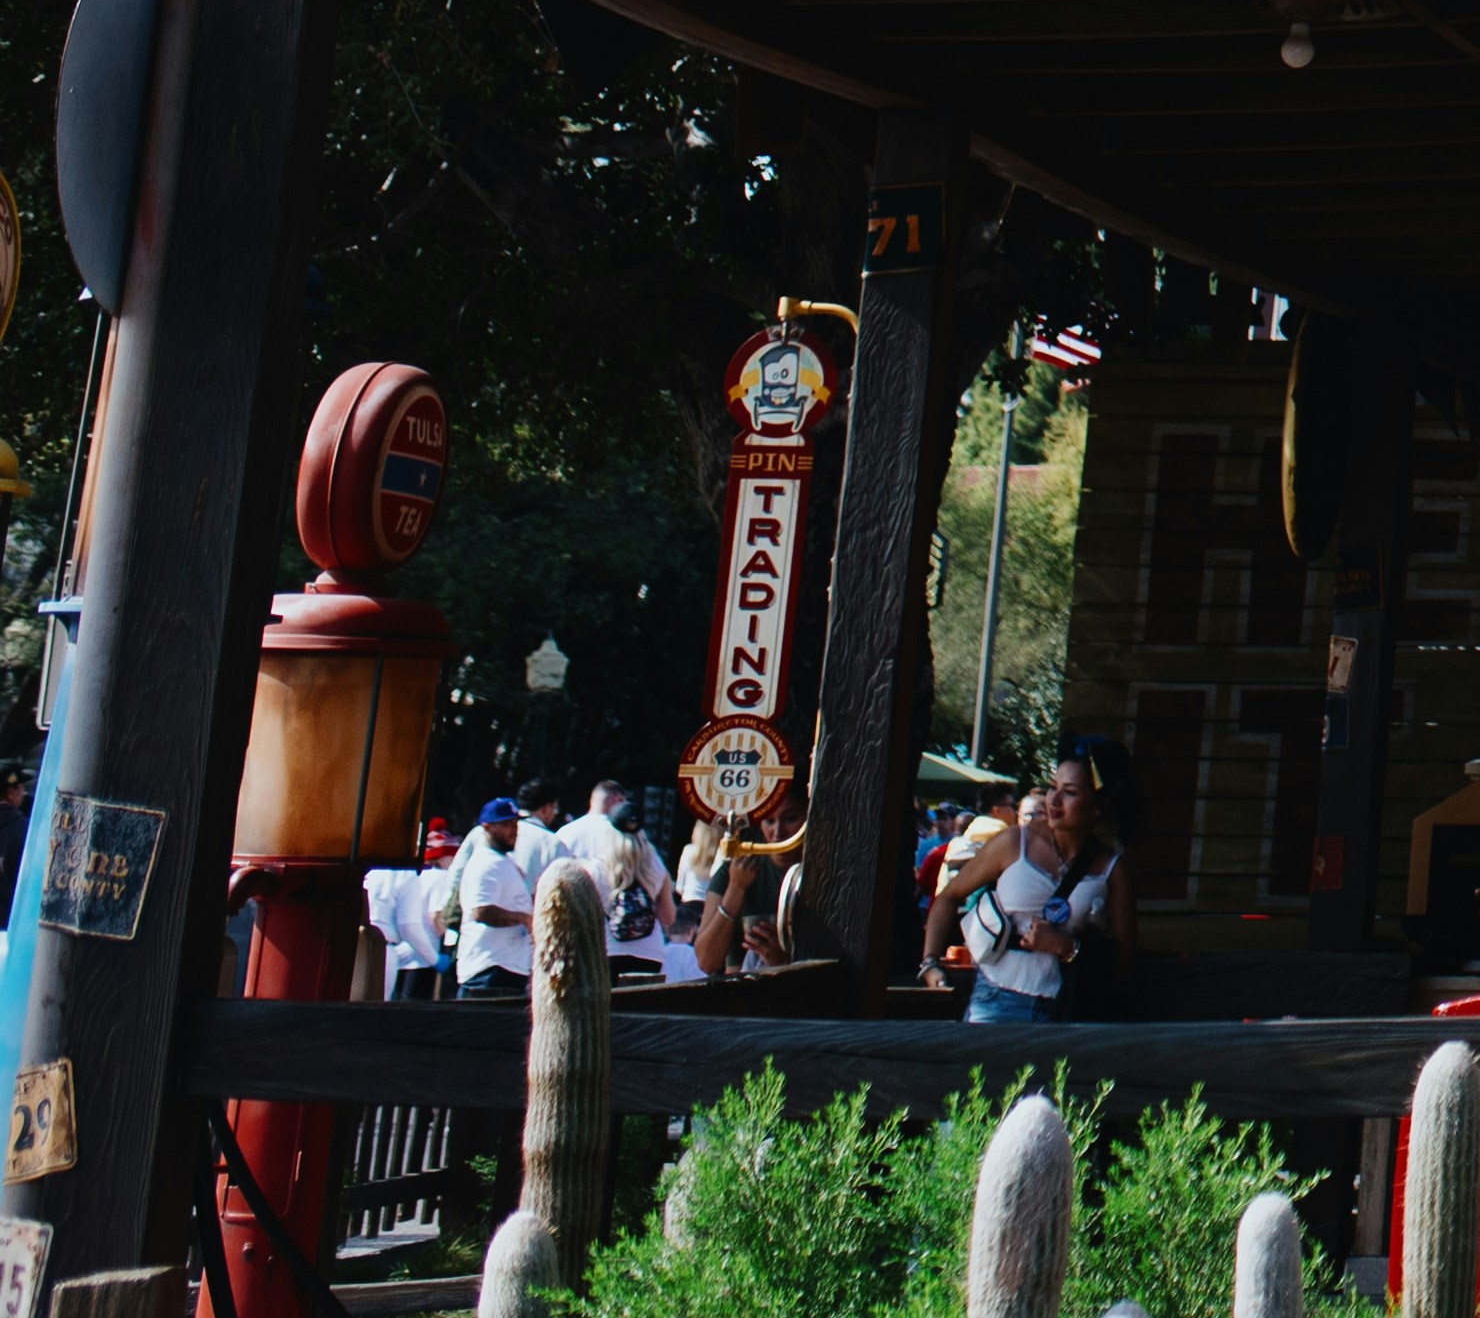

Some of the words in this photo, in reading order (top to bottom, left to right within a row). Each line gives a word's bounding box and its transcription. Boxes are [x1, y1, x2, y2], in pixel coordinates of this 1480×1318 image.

[867, 214, 921, 257] 71
[748, 452, 798, 472] PIN
[394, 504, 423, 538] TEA
[727, 485, 785, 708] TRADING
[728, 752, 748, 764] US
[759, 722, 790, 763] COUNTY
[719, 769, 751, 788] 66
